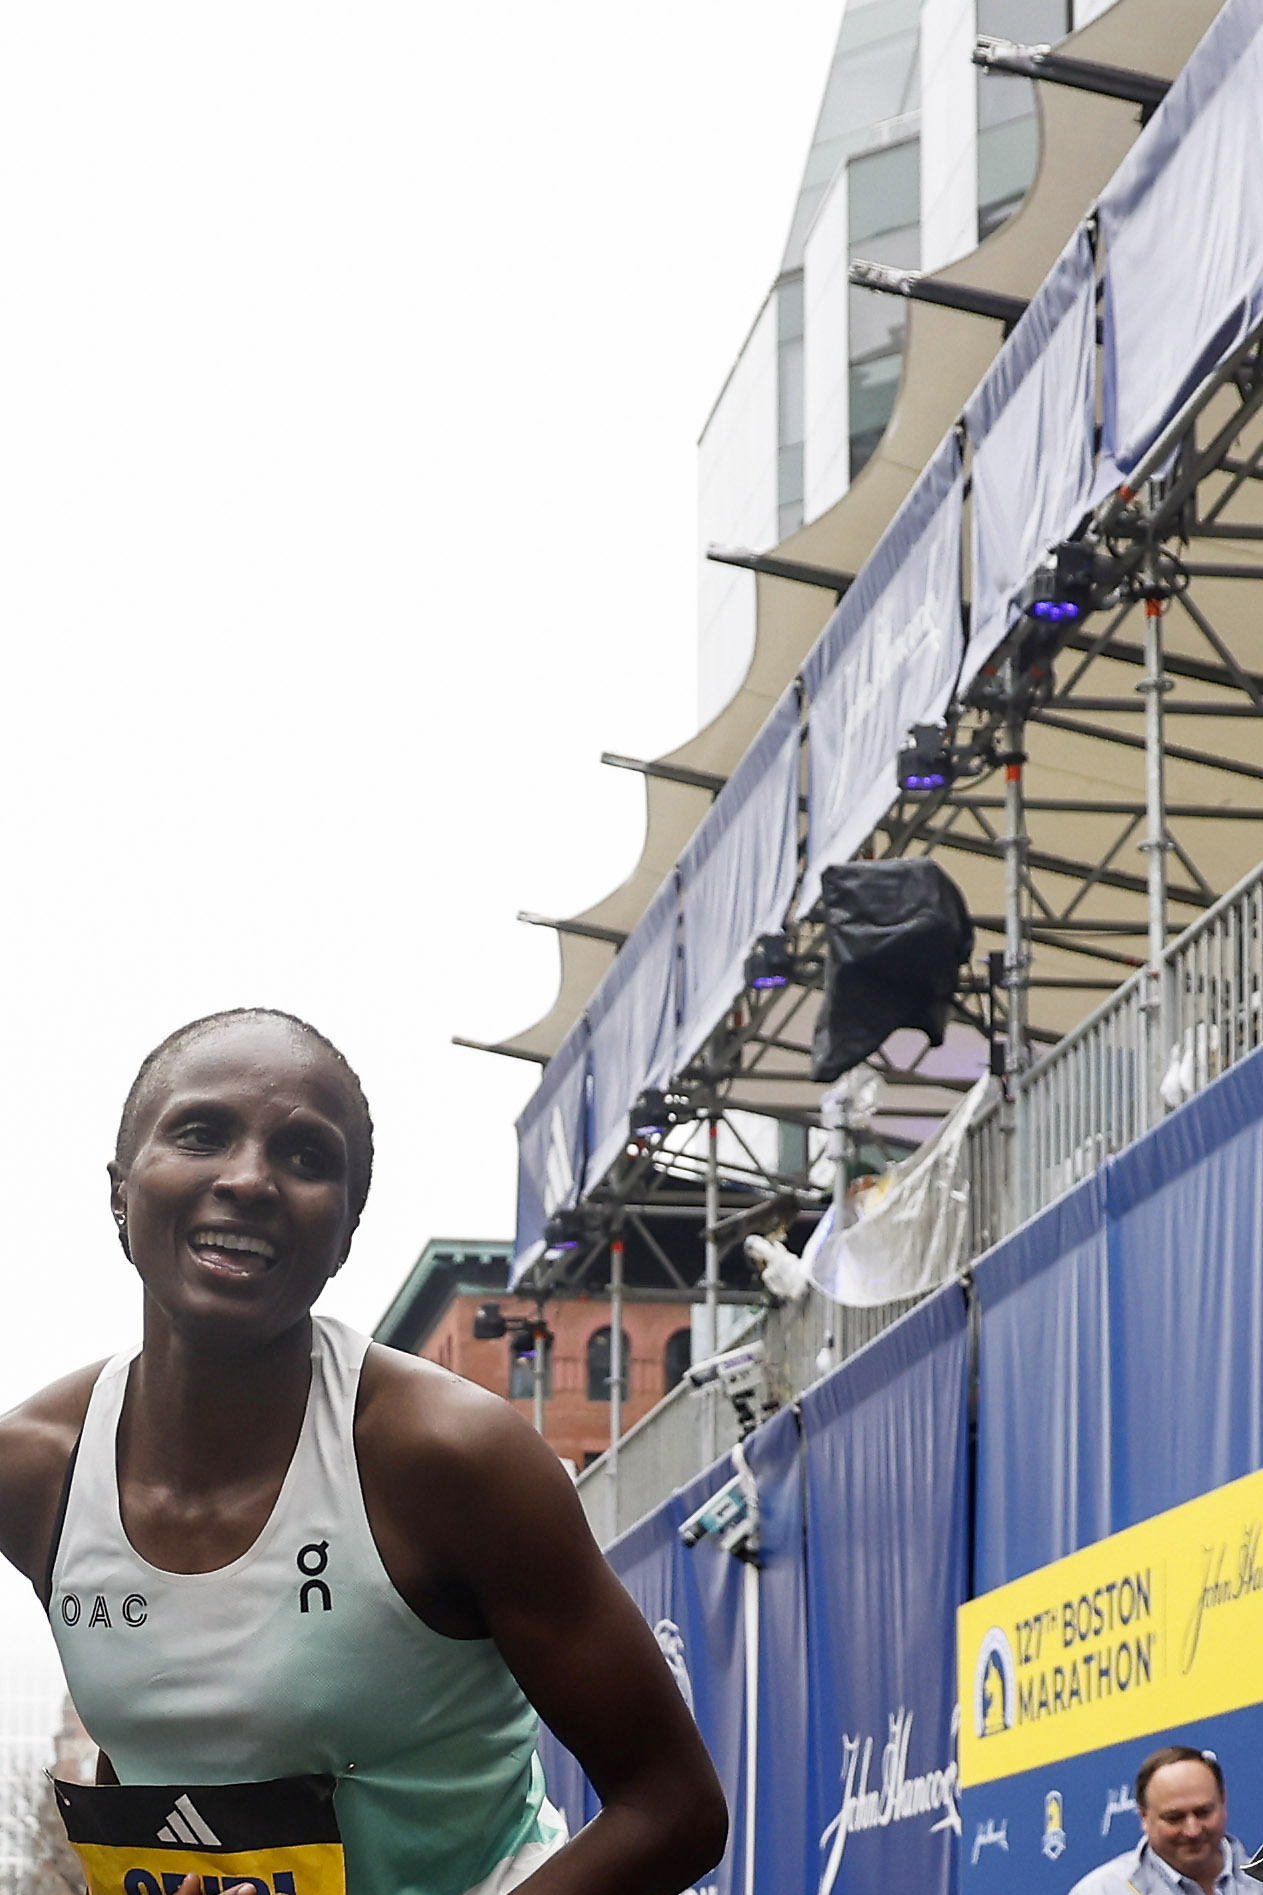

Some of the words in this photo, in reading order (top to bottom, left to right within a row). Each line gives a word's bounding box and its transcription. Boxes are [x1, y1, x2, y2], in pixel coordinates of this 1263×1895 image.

[62, 1593, 148, 1629] OAC
[1063, 1567, 1151, 1649] BOSTON
[1018, 1632, 1153, 1726] MARATHON
